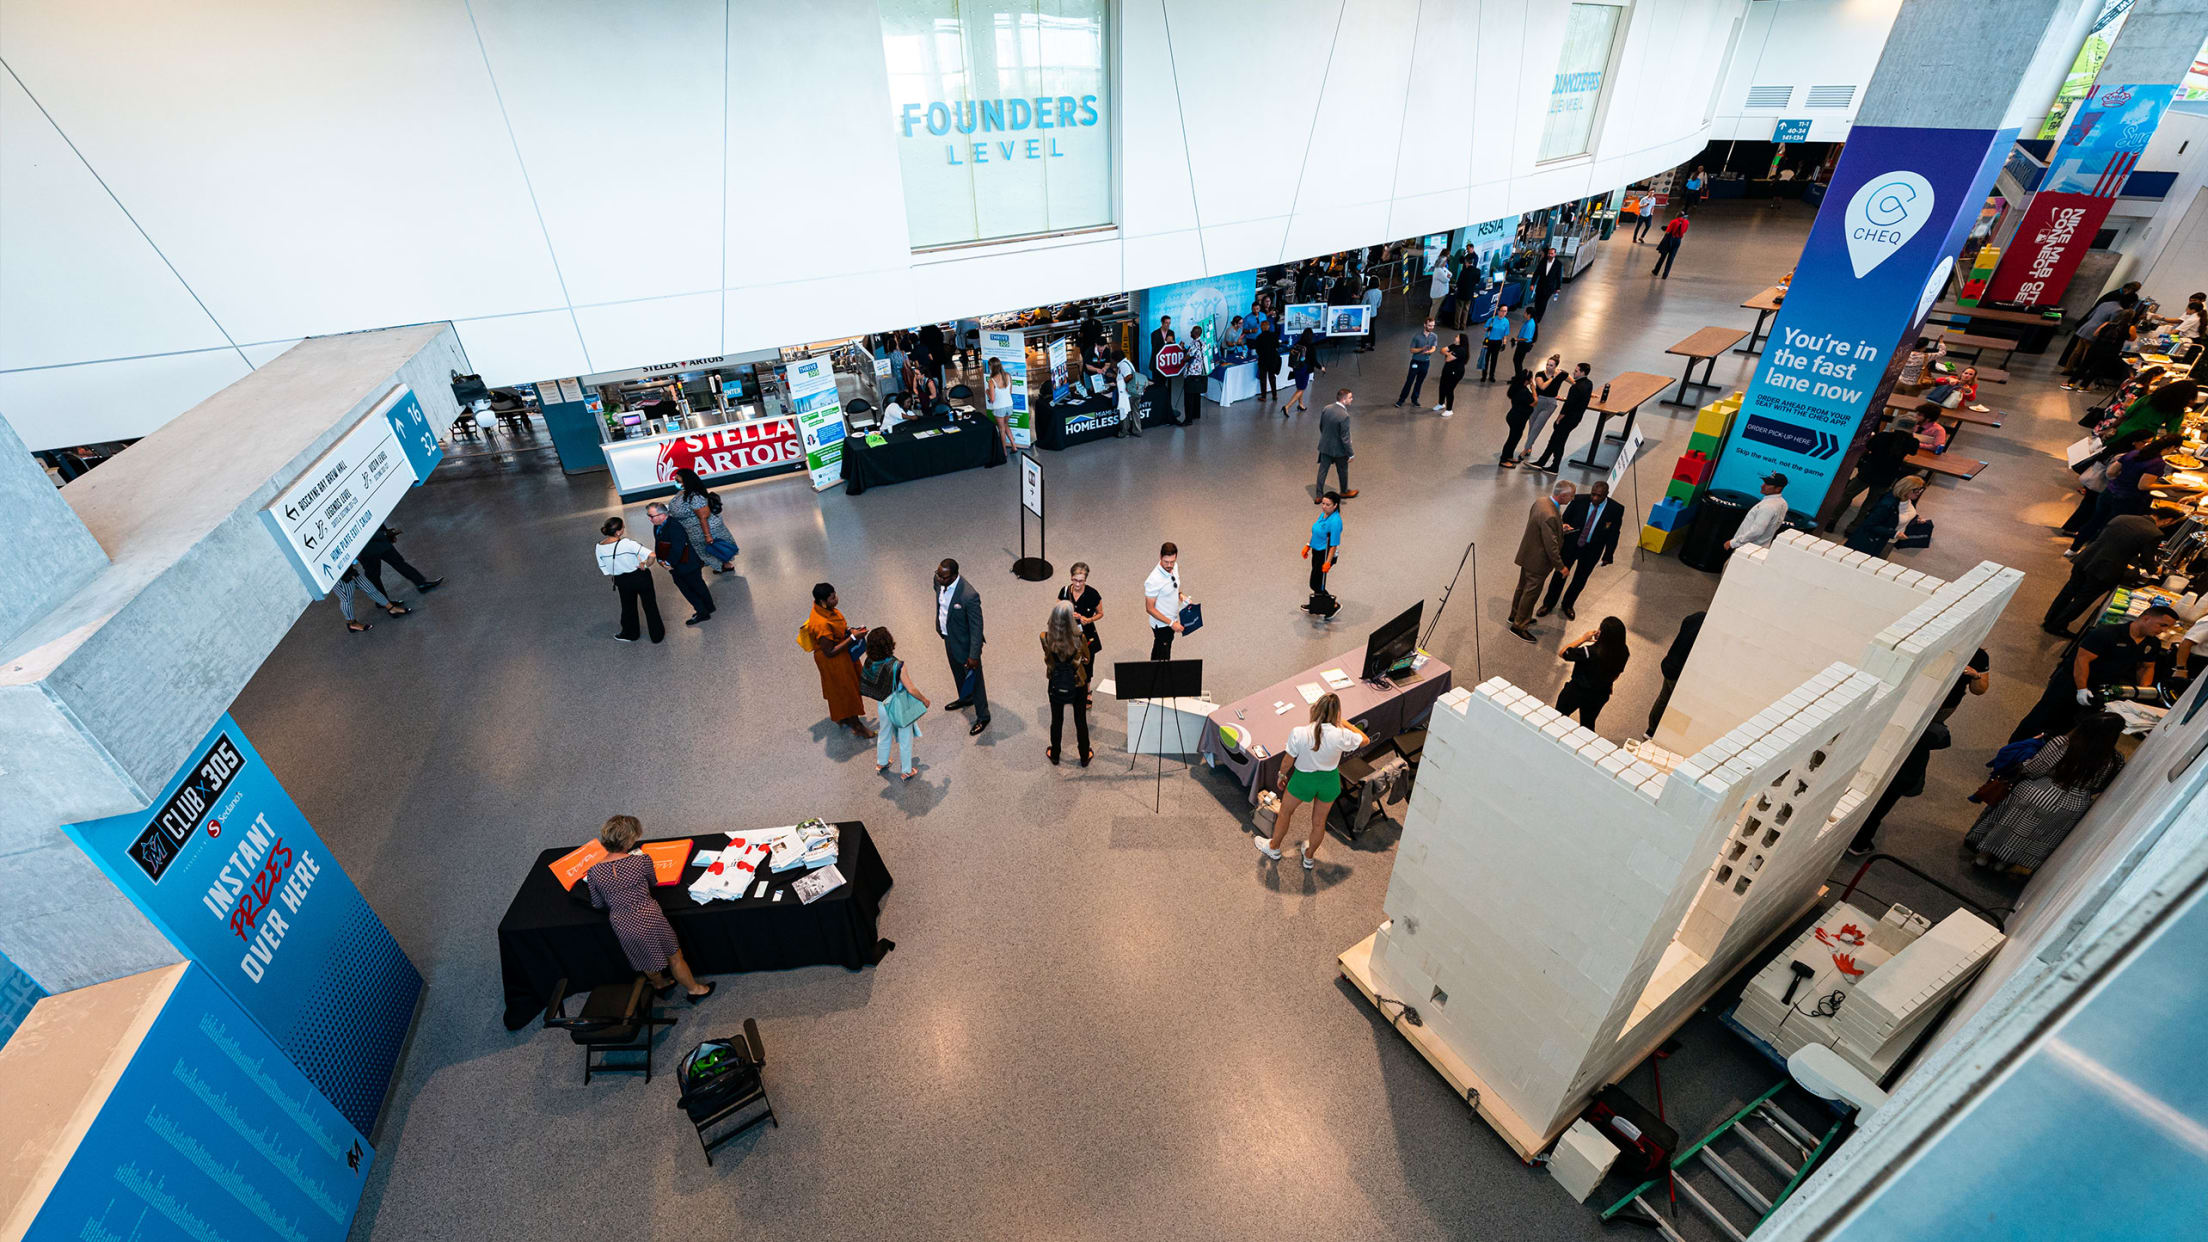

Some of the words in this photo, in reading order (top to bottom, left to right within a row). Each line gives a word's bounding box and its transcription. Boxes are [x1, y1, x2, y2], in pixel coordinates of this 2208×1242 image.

[902, 94, 1098, 138] FOUNDERS
[948, 137, 1064, 165] LEVEL
[1853, 227, 1901, 246] CHEQ
[2058, 208, 2086, 244] NIKE
[2029, 208, 2073, 278] CONNECT
[2039, 246, 2065, 278] MLB
[2026, 281, 2045, 305] CIT
[1159, 352, 1184, 367] STOP
[1784, 326, 1851, 356] You're
[1854, 340, 1878, 362] in
[1773, 348, 1808, 370] the
[1811, 355, 1857, 381] fast
[1764, 366, 1810, 392] lane
[1812, 382, 1863, 404] now
[407, 402, 422, 426] 16
[1755, 399, 1772, 408] SEAT
[1774, 404, 1792, 414] WITH
[1793, 409, 1808, 418] THE
[1808, 412, 1829, 423] CHEQ
[1757, 394, 1781, 404] ORDER
[1781, 399, 1806, 410] AHEAD
[1806, 405, 1829, 415] FROM
[1830, 411, 1851, 421] YOUR
[684, 419, 796, 453] STELLA
[1065, 415, 1120, 435] HOMELESS
[1746, 423, 1768, 434] ORDER
[1793, 436, 1812, 446] HERE
[420, 431, 437, 457] 32
[693, 439, 801, 476] ARTOIS
[1736, 447, 1750, 457] Skip
[1750, 450, 1761, 459] the
[1779, 459, 1791, 468] not
[1791, 462, 1803, 471] the
[1803, 467, 1824, 477] game
[317, 479, 328, 493] BAY
[324, 497, 343, 520] LEGENDS
[340, 488, 352, 504] LEVEL
[329, 545, 343, 562] HOME
[340, 533, 354, 549] PLATE
[162, 786, 205, 840] CLUB
[200, 741, 239, 791] 305
[202, 811, 276, 921] INSTANT
[230, 837, 292, 942] PRIZES
[240, 908, 290, 984] OVER
[280, 849, 321, 915] HERE
